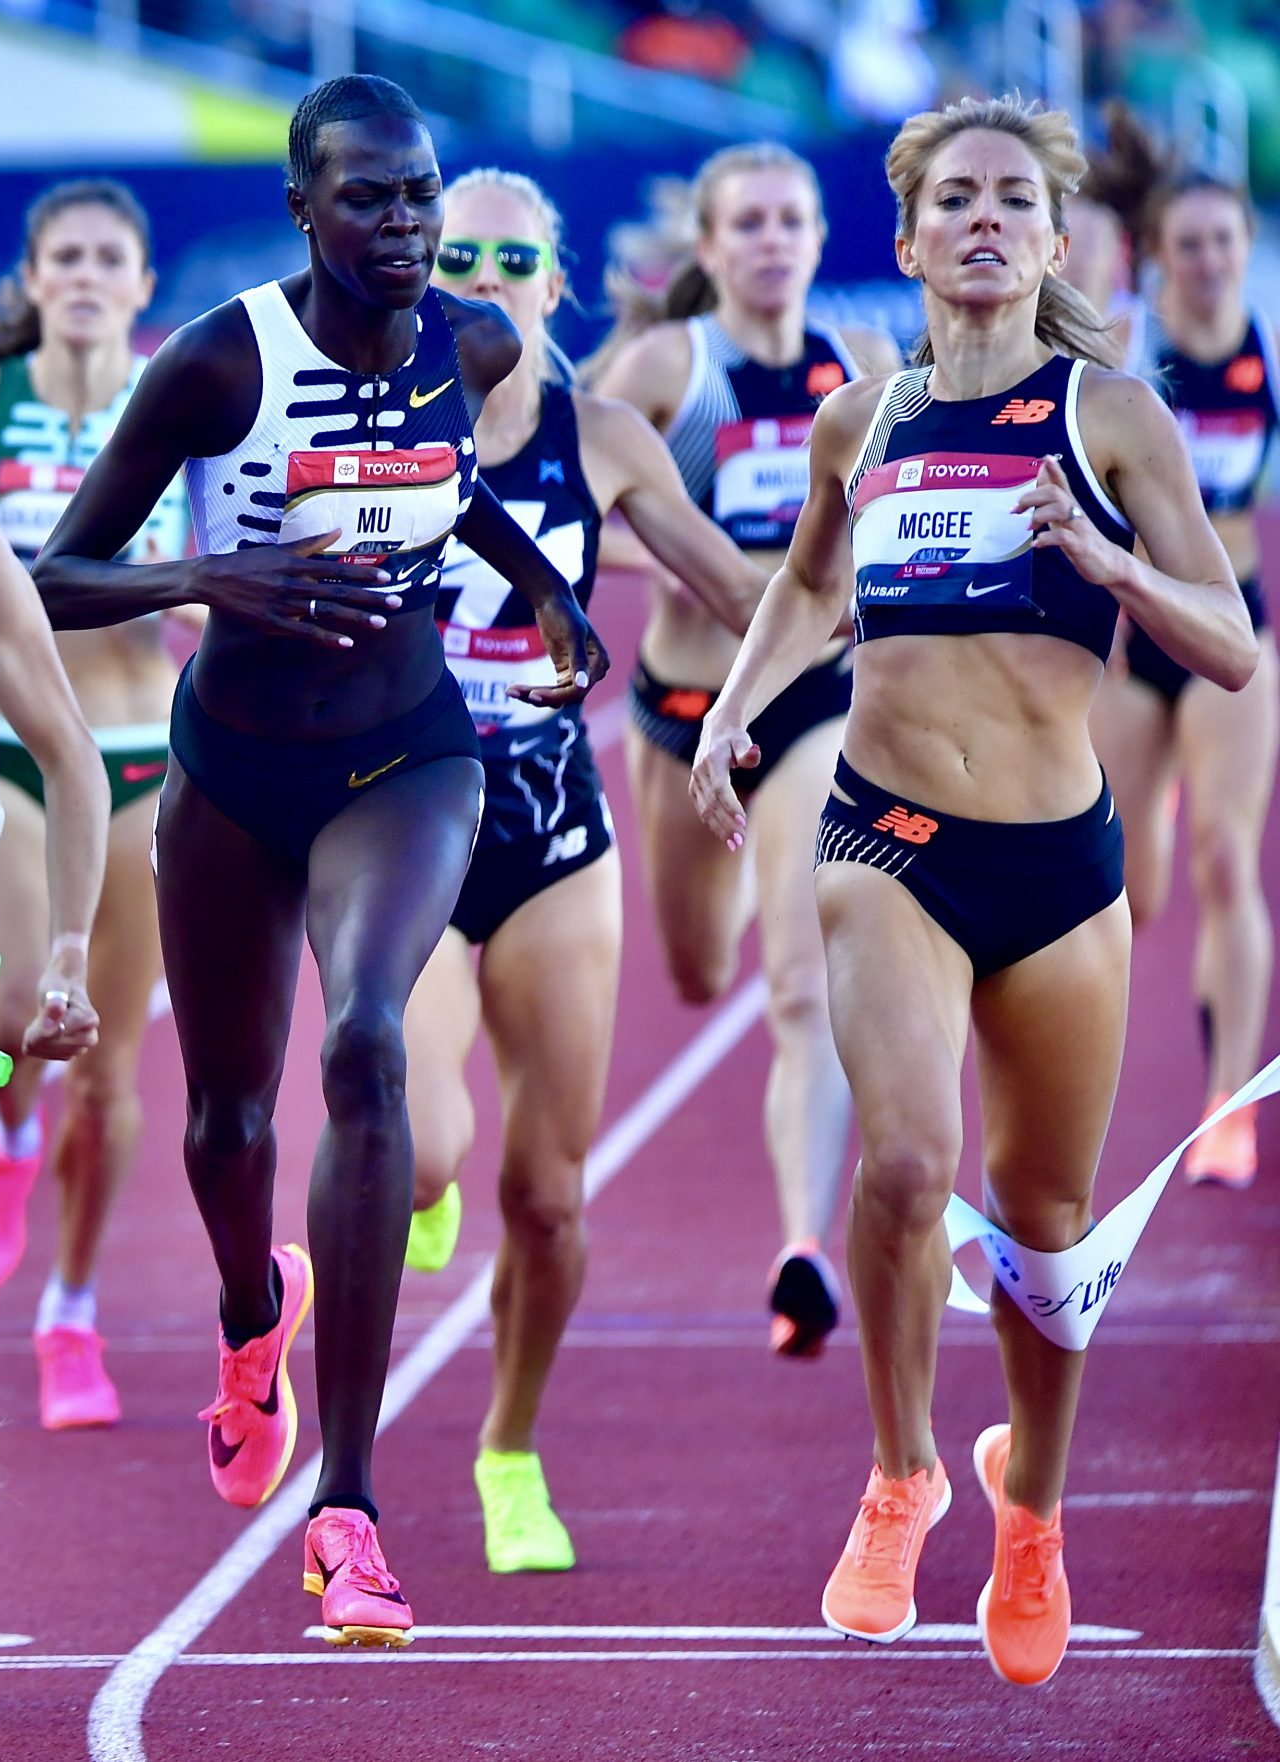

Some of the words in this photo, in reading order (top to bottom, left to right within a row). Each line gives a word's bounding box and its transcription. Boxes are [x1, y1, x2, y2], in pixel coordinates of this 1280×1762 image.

[364, 462, 420, 476] TOYOTA
[927, 464, 990, 478] TOYOTA
[357, 507, 392, 534] MU
[898, 511, 973, 540] MCGEE
[871, 586, 910, 597] USATF
[1079, 1260, 1123, 1316] Life
